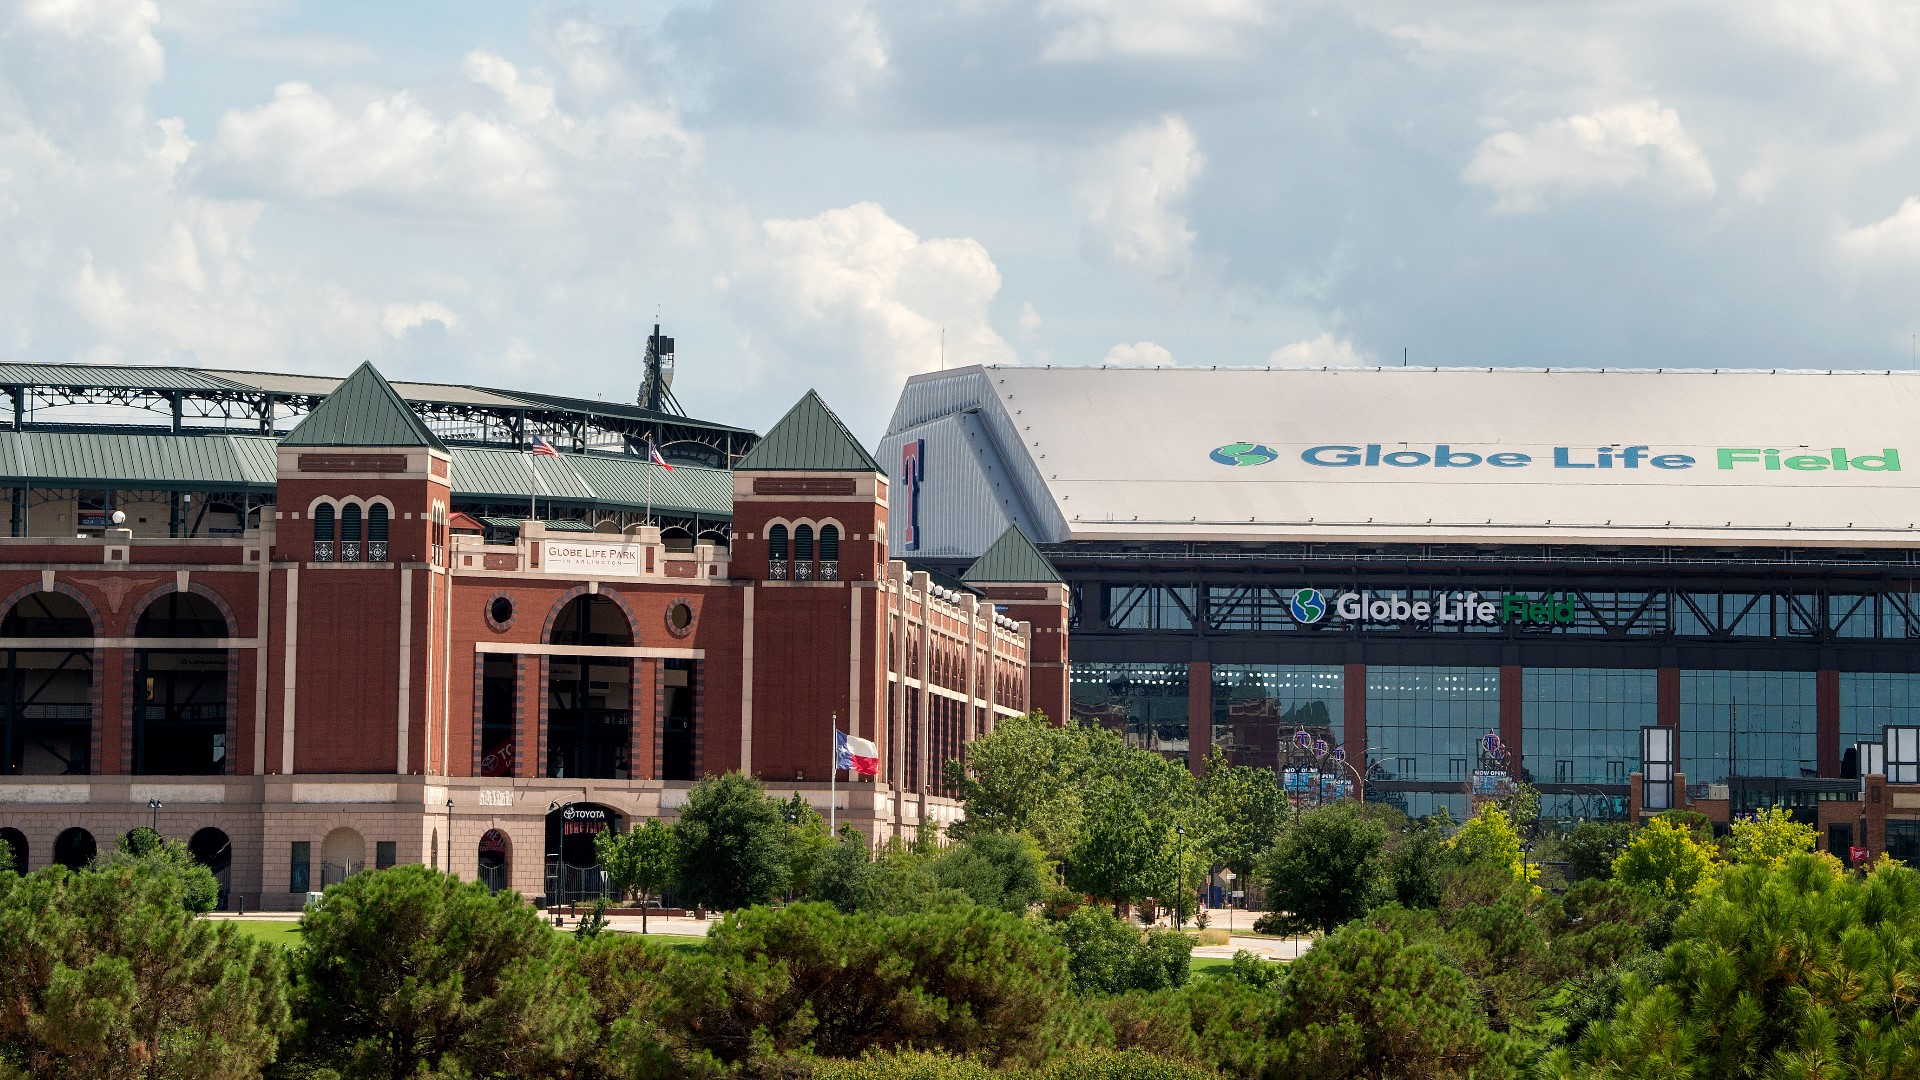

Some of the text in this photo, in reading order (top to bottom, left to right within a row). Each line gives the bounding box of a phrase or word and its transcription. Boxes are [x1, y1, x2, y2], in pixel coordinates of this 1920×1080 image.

[1301, 444, 1901, 471] Globe Life Field
[549, 547, 636, 560] GLOBE LIFE PARK
[1337, 592, 1575, 622] Globe Life Field
[575, 810, 605, 819] TOYOTA
